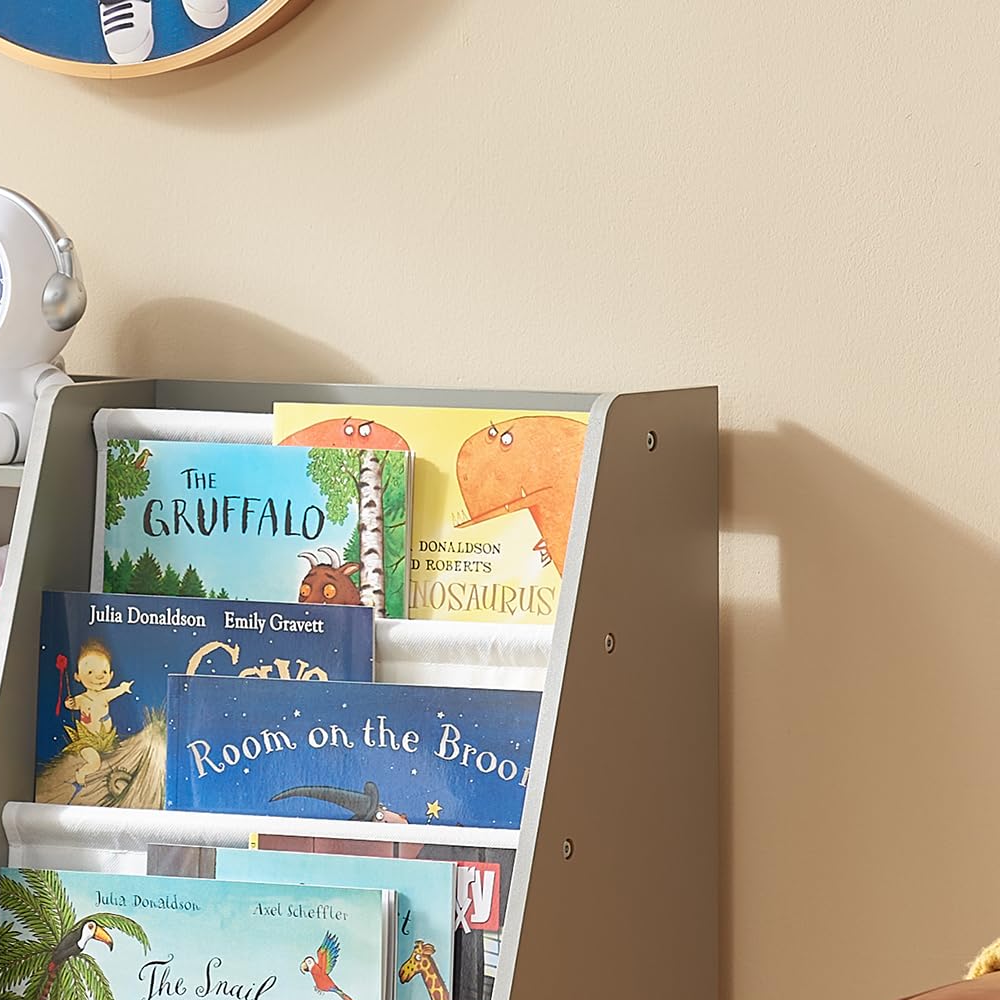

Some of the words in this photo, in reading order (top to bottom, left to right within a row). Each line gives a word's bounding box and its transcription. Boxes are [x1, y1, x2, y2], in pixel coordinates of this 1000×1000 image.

[180, 467, 217, 490] THE
[142, 495, 326, 540] GRUFFALO
[419, 540, 502, 555] DONALDSON
[426, 559, 492, 574] ROBERTS
[410, 580, 556, 617] NOSAURUS
[89, 604, 123, 626] Julia
[127, 606, 206, 628] Donaldson
[224, 611, 266, 634] Emily
[269, 613, 325, 634] Gravett
[186, 727, 297, 779] Room
[307, 722, 355, 750] on
[361, 714, 421, 753] the
[95, 890, 127, 908] Julia
[132, 893, 202, 912] Donaldson
[253, 902, 282, 917] Axel
[287, 903, 349, 921] Scheffler
